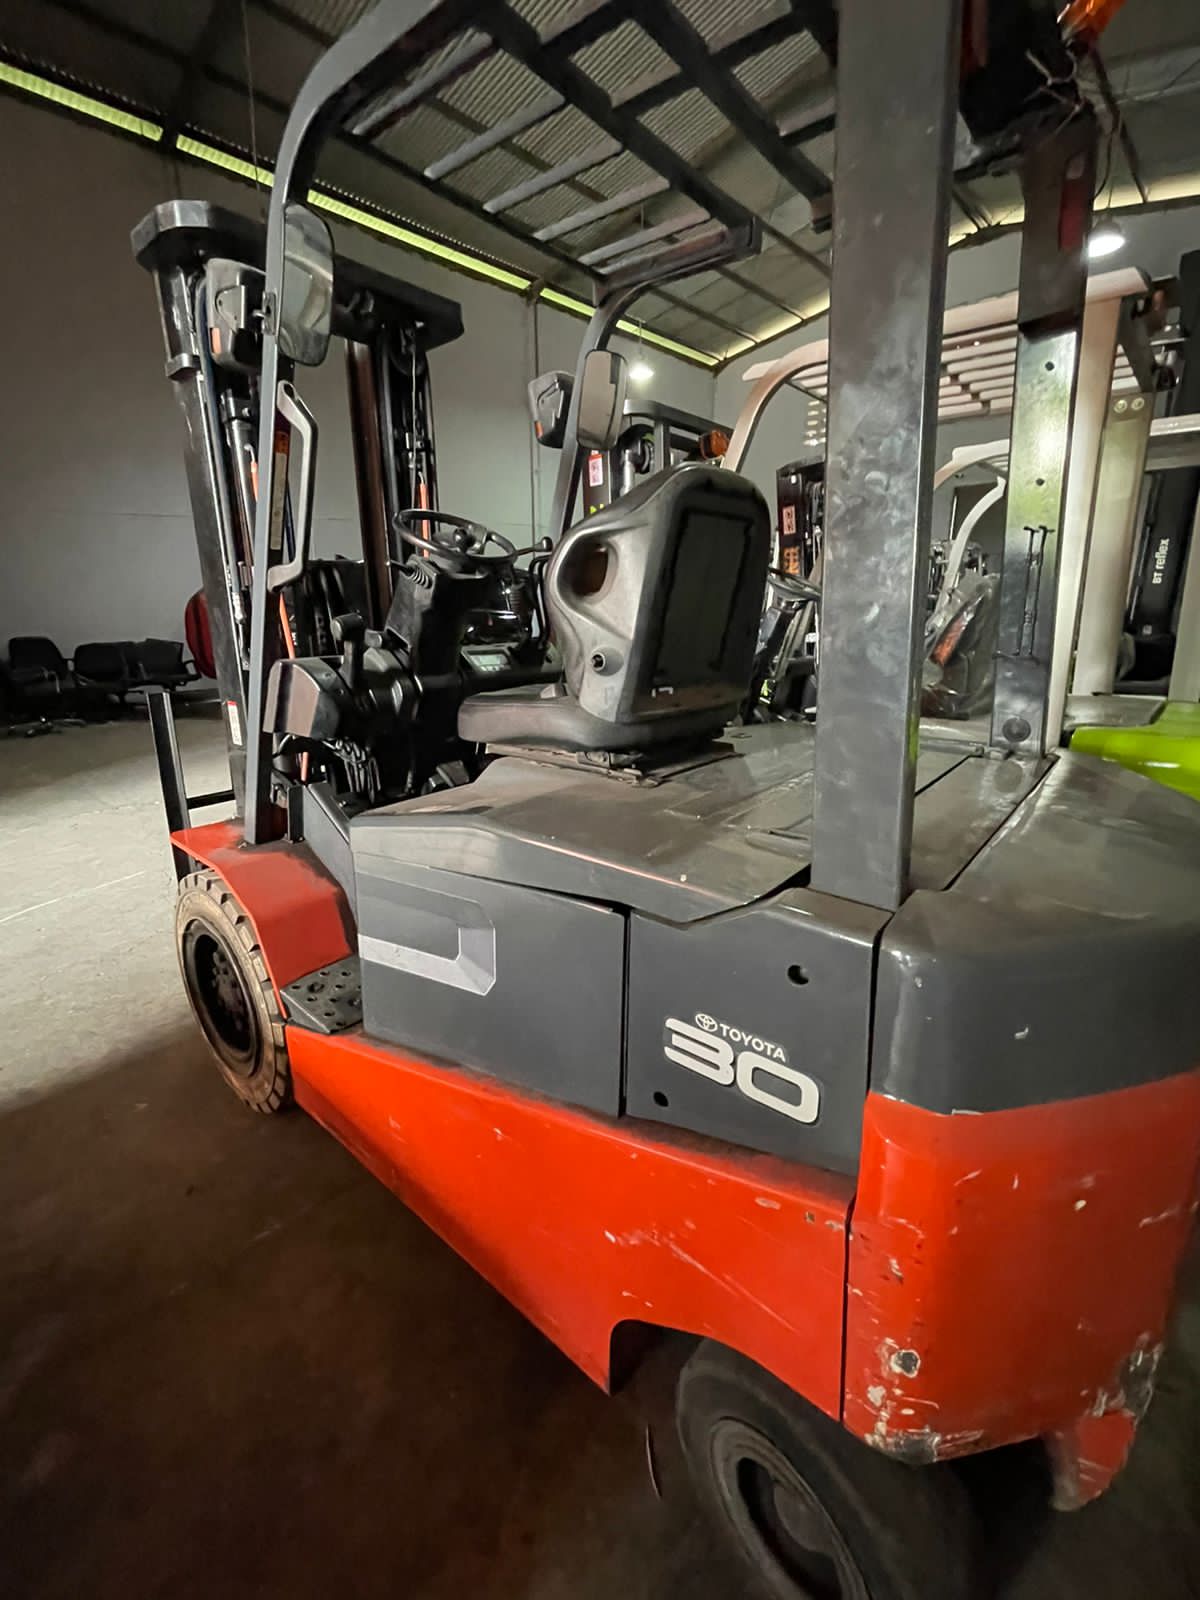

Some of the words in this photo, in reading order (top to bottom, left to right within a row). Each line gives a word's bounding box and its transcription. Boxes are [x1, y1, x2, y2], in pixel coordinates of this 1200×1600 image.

[1155, 538, 1170, 570] reflex
[1152, 571, 1163, 585] BT
[720, 1023, 786, 1062] TOYOTA
[664, 1017, 819, 1124] 30
